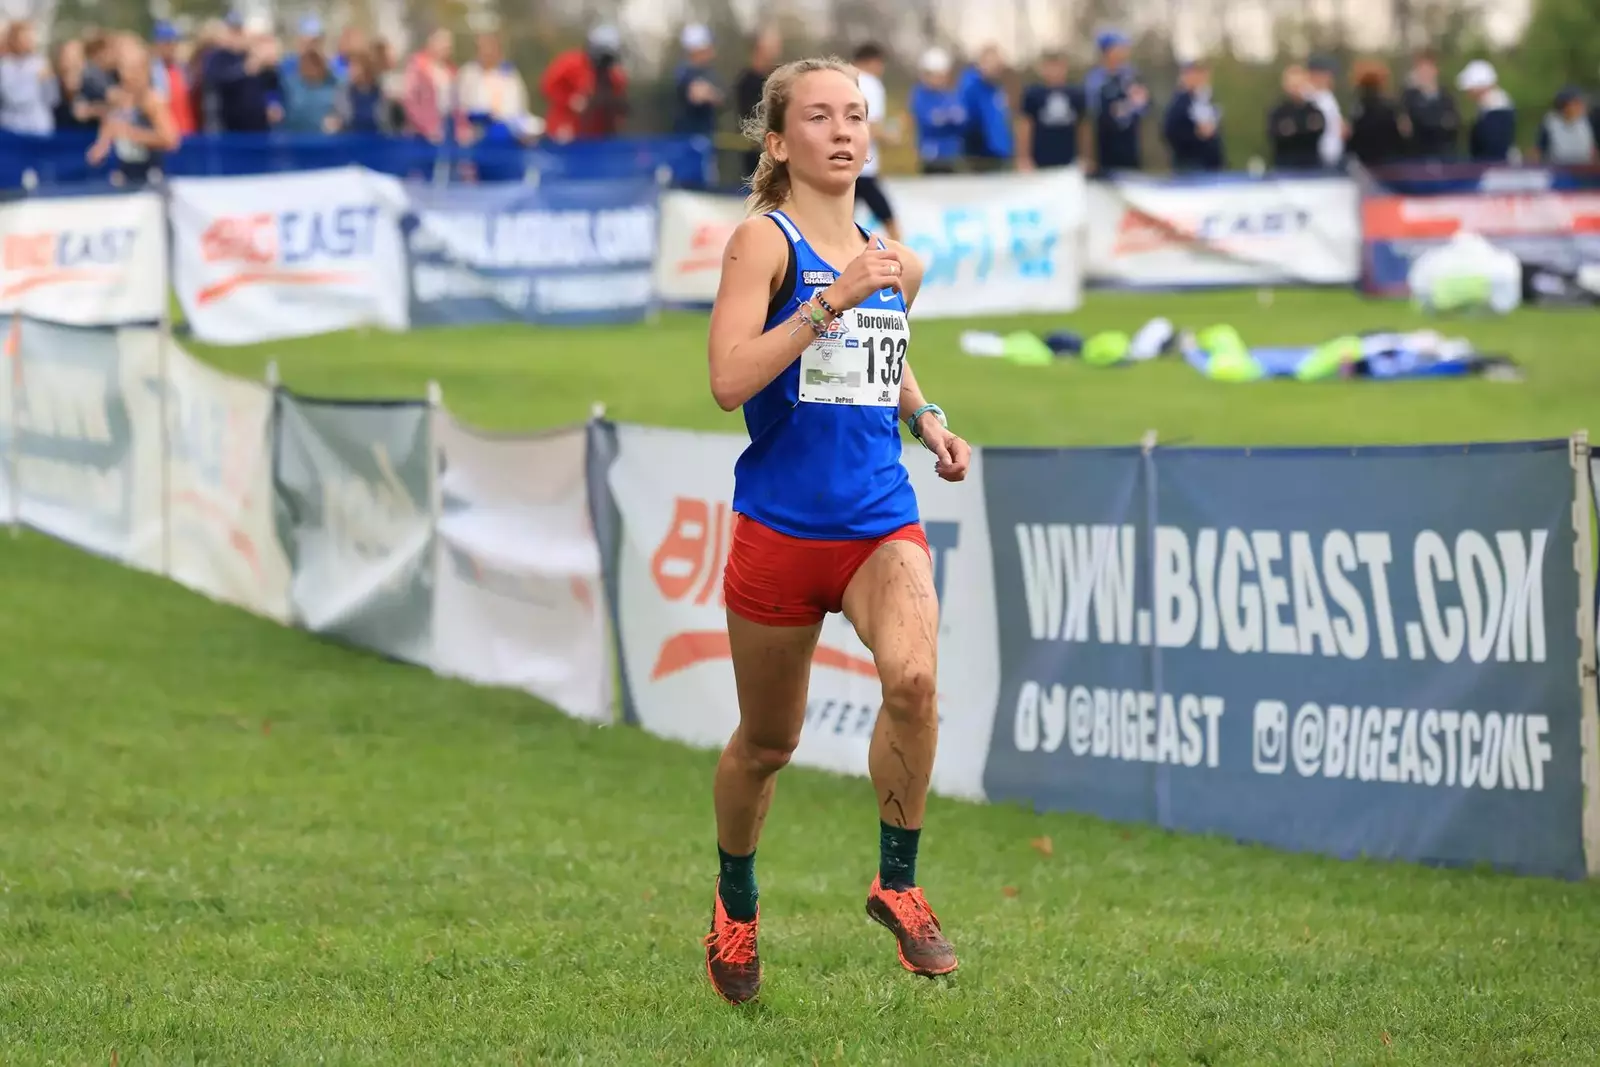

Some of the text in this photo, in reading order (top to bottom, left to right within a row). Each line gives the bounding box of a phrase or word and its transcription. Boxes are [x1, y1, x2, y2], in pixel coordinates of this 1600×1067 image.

[857, 313, 904, 331] Borowiak
[862, 336, 907, 387] 133
[1015, 523, 1549, 664] WWW.BIGEAST.COM
[1068, 685, 1552, 792] @BIGEAST @BIGEASTCONF
